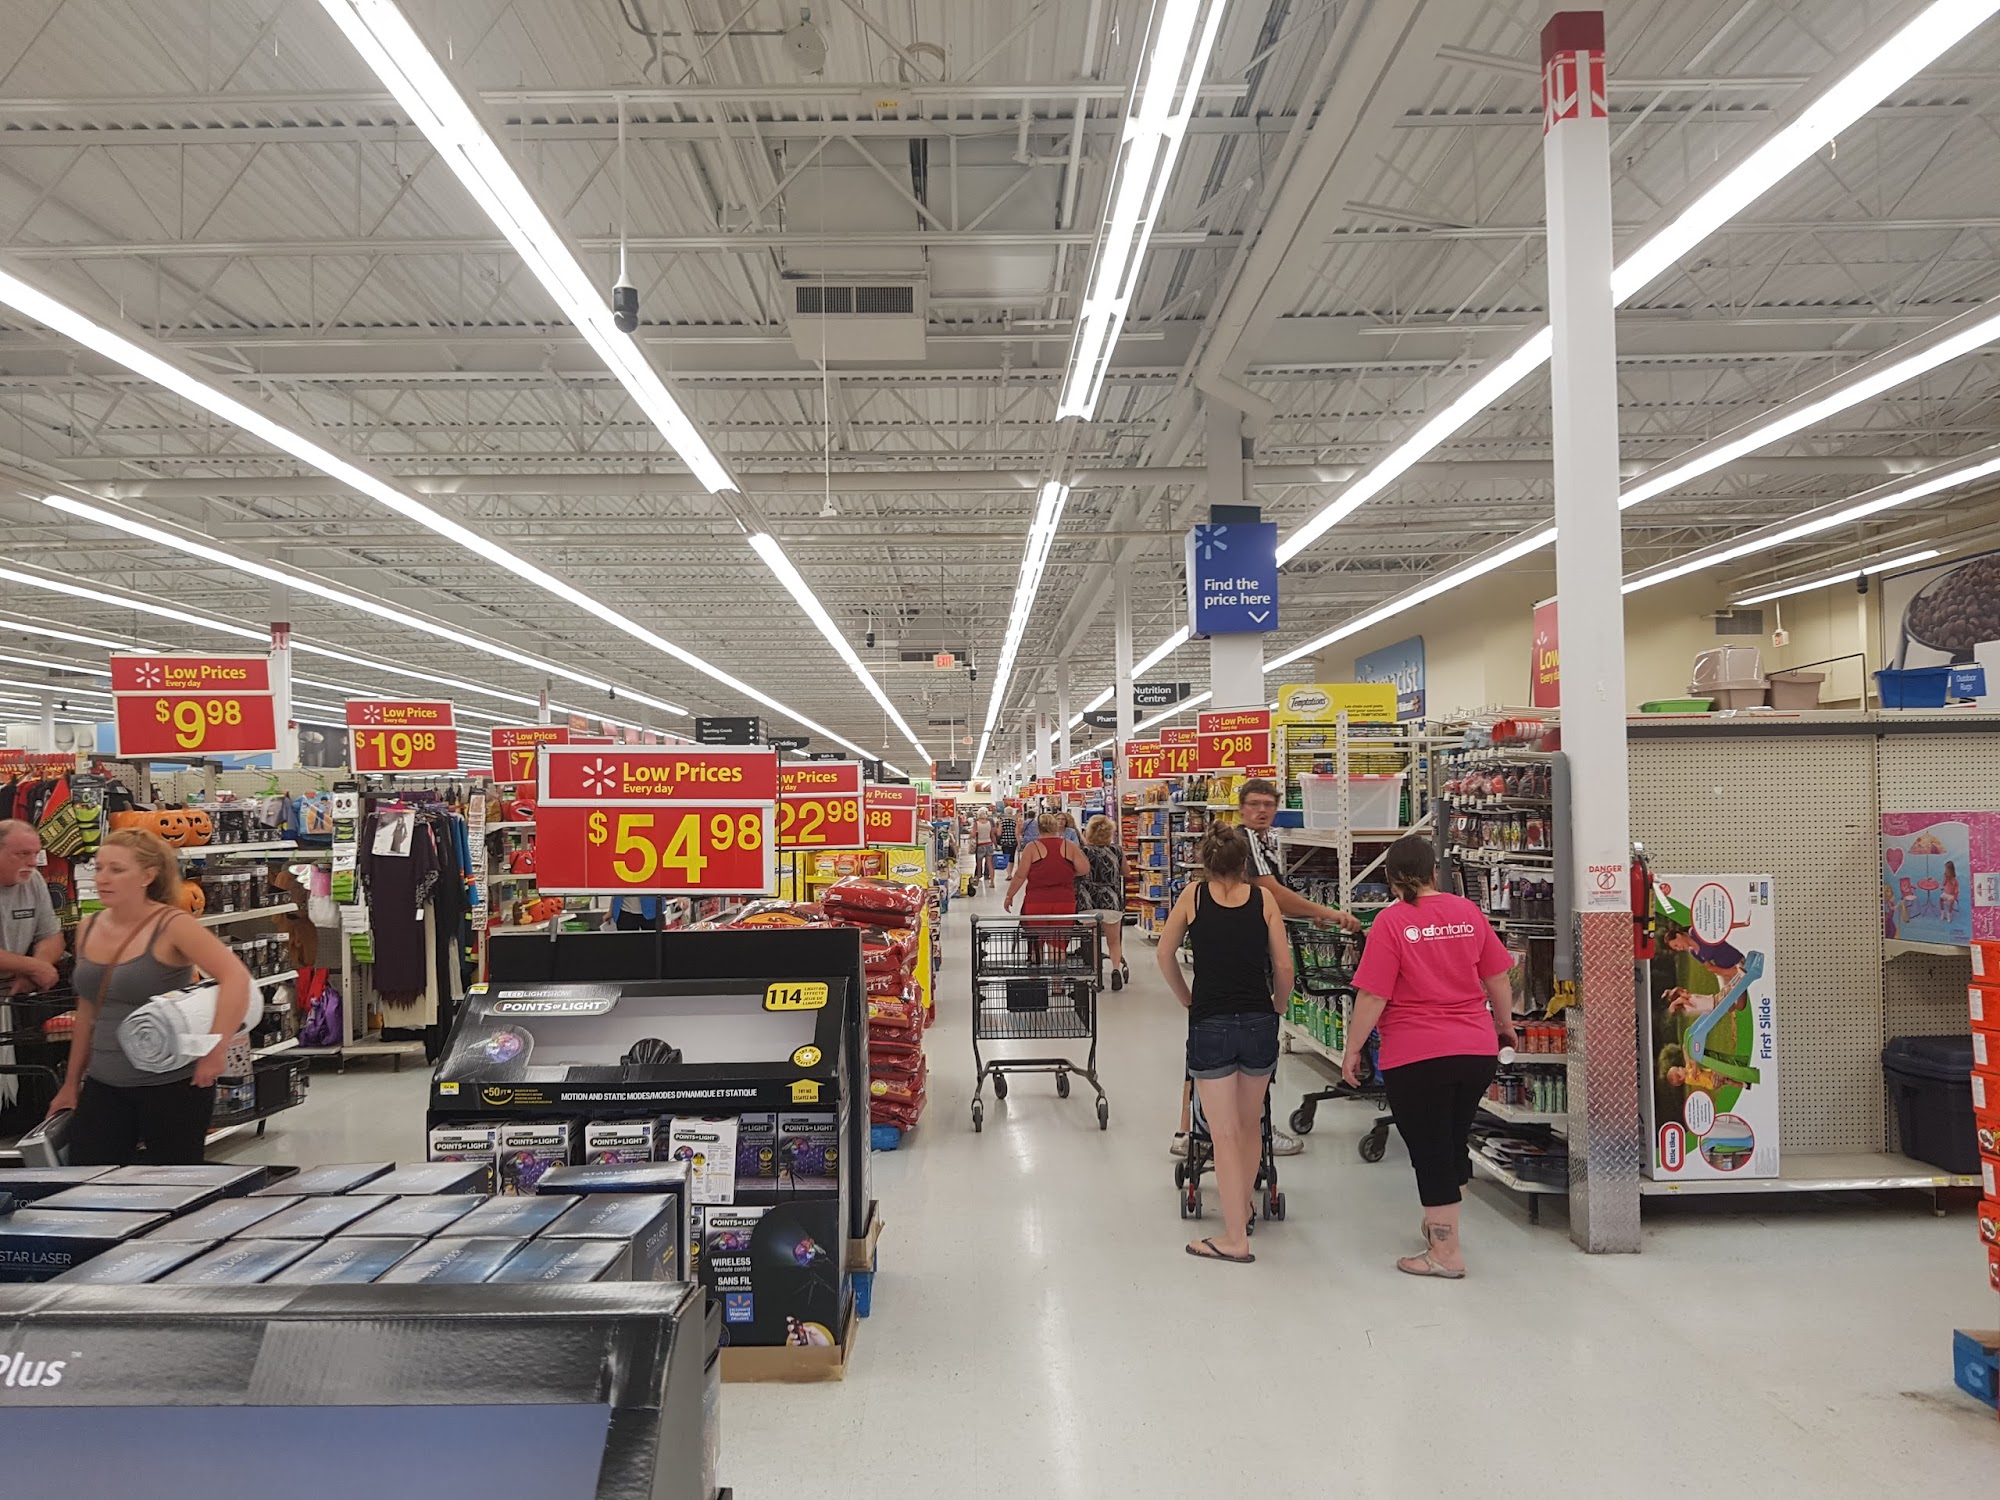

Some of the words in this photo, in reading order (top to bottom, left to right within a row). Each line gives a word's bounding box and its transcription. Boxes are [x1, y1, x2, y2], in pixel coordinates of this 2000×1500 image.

[1204, 577, 1233, 591] Find
[1236, 577, 1259, 590] the
[1204, 593, 1238, 610] price
[1240, 592, 1271, 605] here
[1540, 648, 1559, 671] Low
[164, 665, 197, 679] Low
[200, 665, 247, 679] Prices
[165, 679, 186, 688] Every
[187, 679, 201, 688] day
[1133, 685, 1172, 695] Nutrition
[1137, 694, 1167, 703] Centre
[382, 706, 405, 718] Low
[407, 707, 438, 718] Prices
[1096, 715, 1117, 723] Pharm
[1220, 717, 1236, 726] Low
[1236, 715, 1259, 725] Prices
[516, 732, 532, 740] Low
[533, 732, 558, 741] Prices
[623, 761, 671, 782] Low
[675, 761, 743, 783] Prices
[797, 771, 838, 784] Prices
[623, 783, 652, 795] Every
[653, 783, 674, 796] day
[874, 789, 903, 800] Prices
[1588, 865, 1622, 873] DANGER
[864, 954, 887, 964] ALP
[866, 982, 889, 992] ALP
[769, 988, 802, 1005] 114
[502, 1002, 553, 1012] POINTS
[561, 1001, 603, 1011] LIGHT
[1759, 997, 1771, 1029] Slide
[1760, 1032, 1772, 1059] First
[488, 1087, 501, 1097] 50
[561, 1092, 588, 1101] MOTION
[588, 1092, 603, 1101] AND
[603, 1092, 626, 1100] STATIC
[626, 1091, 676, 1100] MODES/MODES
[676, 1089, 716, 1099] DYNAMIQUE
[716, 1089, 725, 1098] ET
[725, 1088, 758, 1098] STATIQUE
[466, 1142, 488, 1150] LIGHT
[508, 1138, 534, 1146] POINTS
[538, 1137, 560, 1145] LIGHT
[592, 1138, 618, 1146] POINTS
[622, 1137, 643, 1145] LIGHT
[712, 1219, 738, 1227] POINTS
[32, 1252, 72, 1265] LASER
[711, 1257, 751, 1267] WIRELESS
[717, 1276, 739, 1285] SANS
[740, 1276, 752, 1285] FIL
[0, 1352, 67, 1387] Plus
